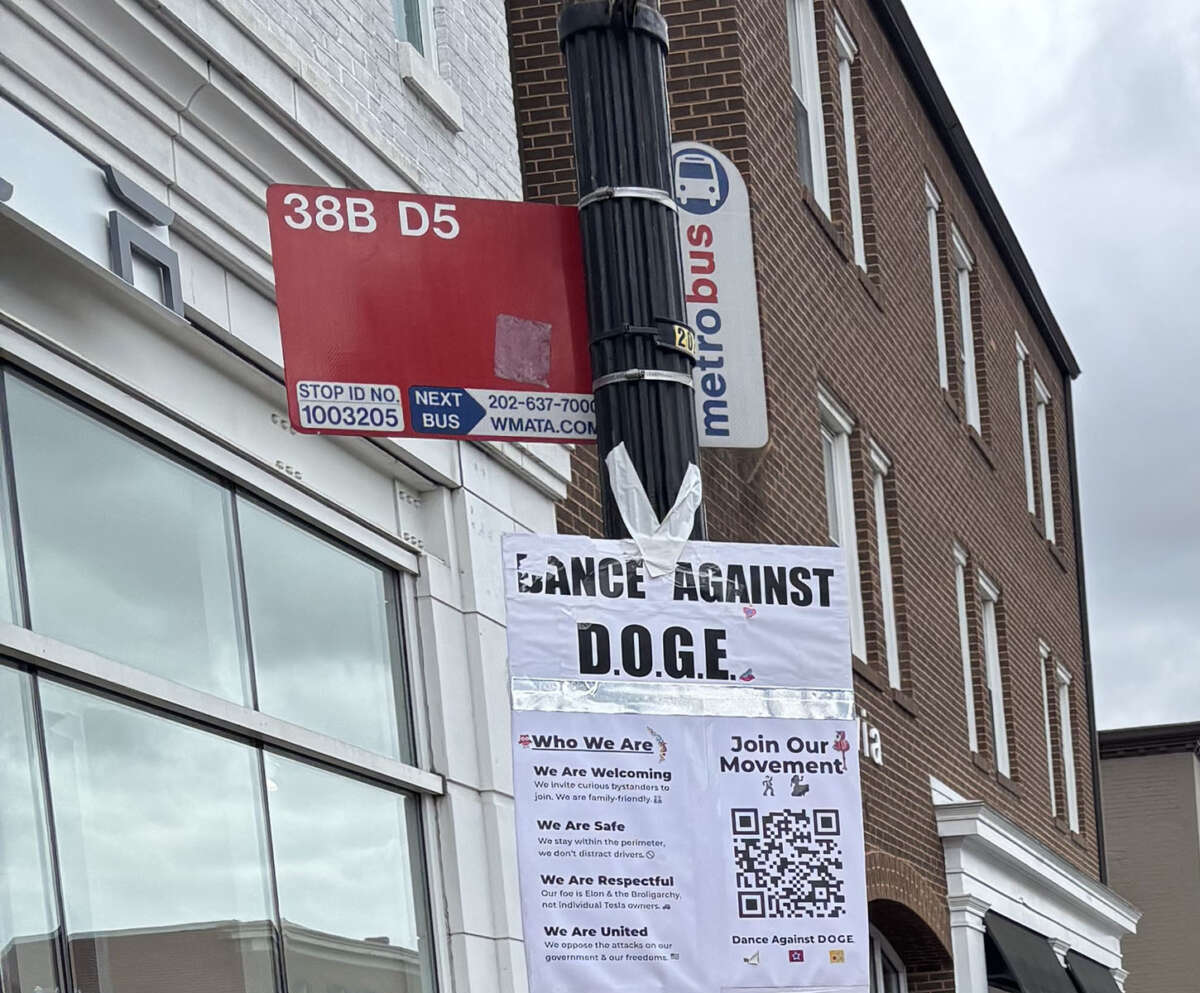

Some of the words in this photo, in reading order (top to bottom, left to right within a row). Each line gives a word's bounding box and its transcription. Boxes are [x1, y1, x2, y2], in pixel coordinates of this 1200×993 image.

[283, 192, 378, 235] 38B
[398, 199, 461, 240] D5
[299, 383, 344, 400] STOP
[349, 386, 365, 401] ID
[371, 387, 400, 403] NO.
[415, 390, 463, 407] NEXT
[301, 405, 398, 428] 1003205
[422, 413, 460, 429] BUS
[490, 416, 598, 435] WMATA.COM
[673, 560, 835, 607] AGAINST
[577, 622, 737, 681] D.O.G.E.
[531, 735, 578, 748] Who
[583, 736, 615, 749] We
[620, 737, 653, 751] Are
[731, 734, 779, 753] Join
[786, 736, 829, 754] Our
[720, 756, 844, 774] Movement
[533, 766, 558, 776] We
[561, 766, 587, 777] Are
[590, 767, 672, 782] Welcoming
[534, 781, 549, 789] We
[550, 781, 576, 789] invite
[577, 782, 610, 790] curious
[611, 783, 659, 791] bystanders
[536, 820, 561, 830] We
[565, 820, 590, 831] Are
[594, 821, 625, 832] Safe
[554, 838, 573, 846] stay
[574, 837, 603, 845] within
[604, 838, 619, 846] the
[578, 850, 612, 858] distract
[540, 874, 564, 885] We
[568, 875, 594, 885] Are
[598, 875, 674, 888] Respectful
[614, 890, 629, 898] the
[558, 901, 602, 909] individual
[604, 901, 626, 909] Tesla
[543, 926, 568, 936] We
[571, 926, 597, 937] Are
[601, 925, 648, 937] United
[611, 941, 643, 949] attacks
[732, 935, 769, 944] Dance
[771, 934, 815, 946] Against
[817, 934, 854, 944] DOGE
[545, 954, 599, 962] government
